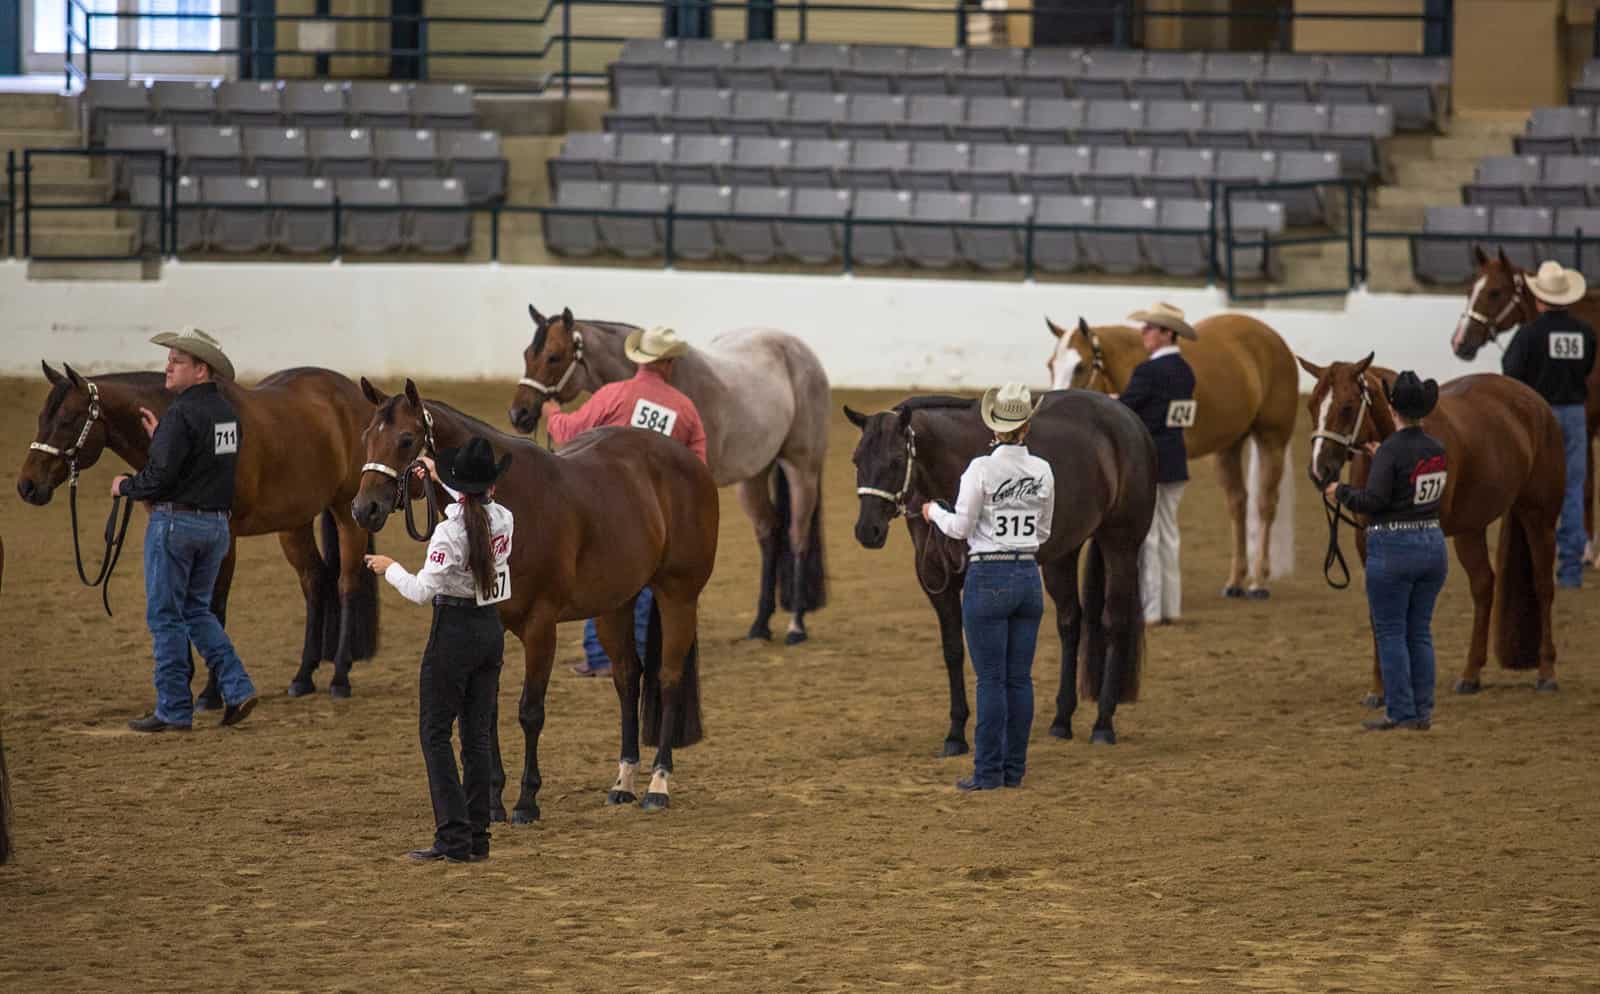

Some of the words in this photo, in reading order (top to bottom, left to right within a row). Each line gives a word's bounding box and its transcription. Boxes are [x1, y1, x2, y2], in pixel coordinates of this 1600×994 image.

[1554, 336, 1579, 355] 636
[637, 406, 669, 433] 584
[216, 431, 236, 447] 711
[1418, 478, 1441, 501] 571
[995, 515, 1036, 537] 315
